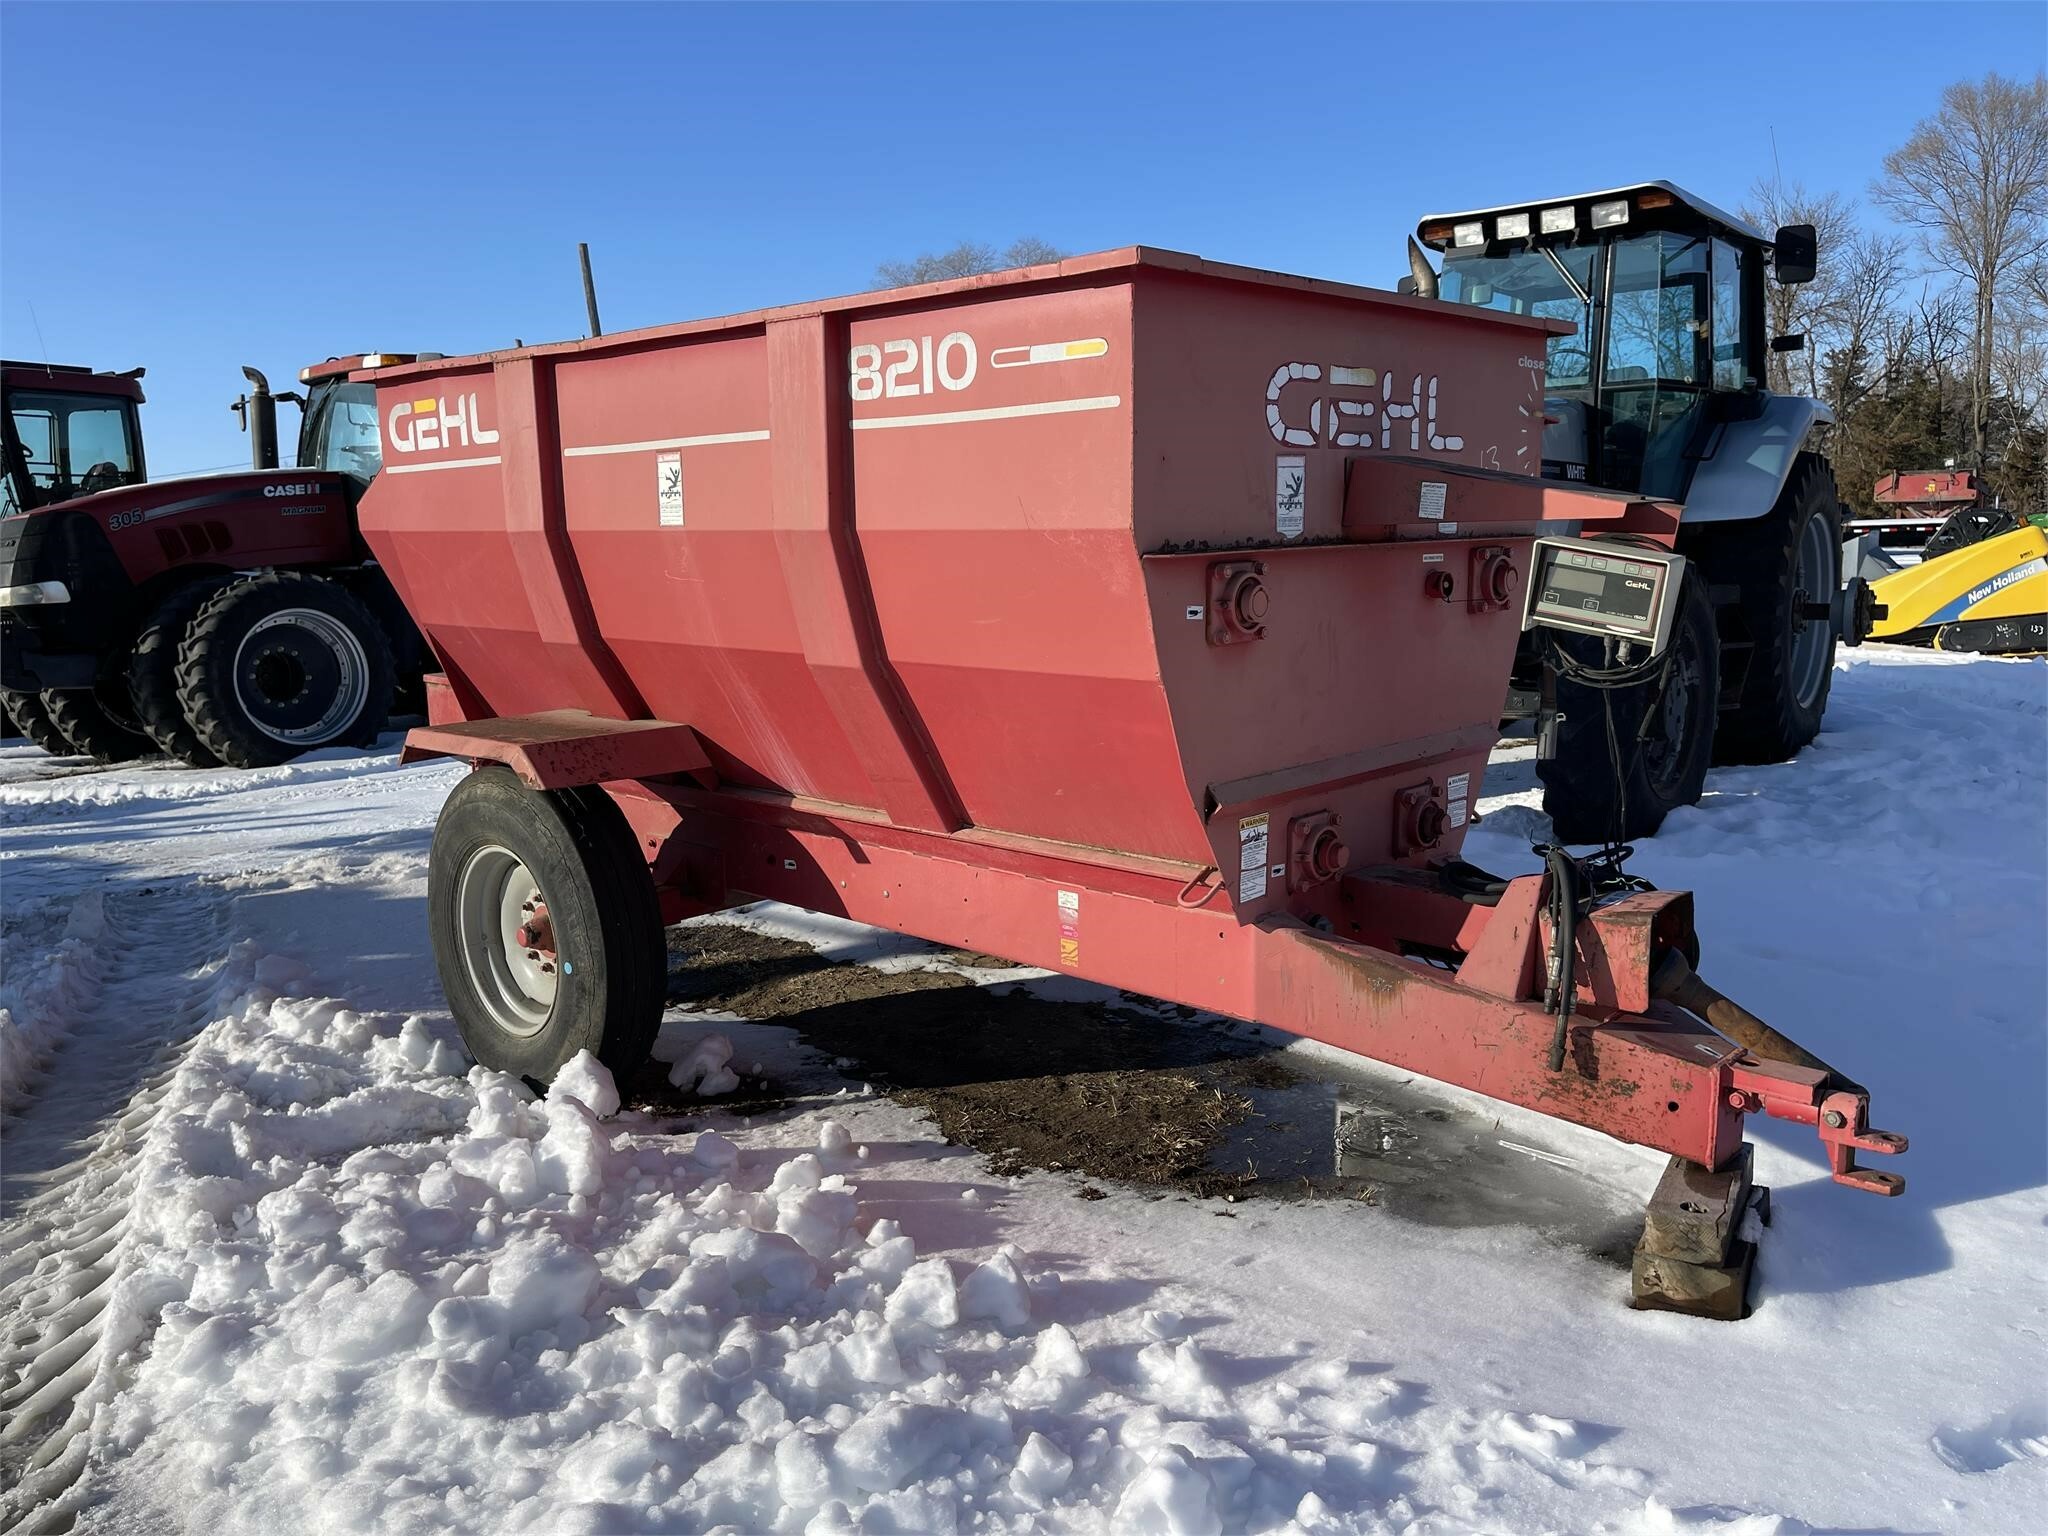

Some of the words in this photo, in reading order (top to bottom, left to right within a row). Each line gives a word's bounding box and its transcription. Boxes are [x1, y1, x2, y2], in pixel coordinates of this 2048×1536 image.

[848, 331, 978, 401] 8210
[1518, 356, 1545, 370] close
[1265, 362, 1464, 450] GEHL
[388, 393, 500, 452] GEHL
[1566, 463, 1586, 480] WHITE
[263, 484, 306, 498] CASE
[109, 507, 146, 531] 305
[281, 505, 327, 516] MAGNUM
[1625, 580, 1652, 591] GEHL
[1967, 584, 1992, 605] New
[1992, 563, 2035, 591] Holland
[1245, 816, 1268, 827] WARNING
